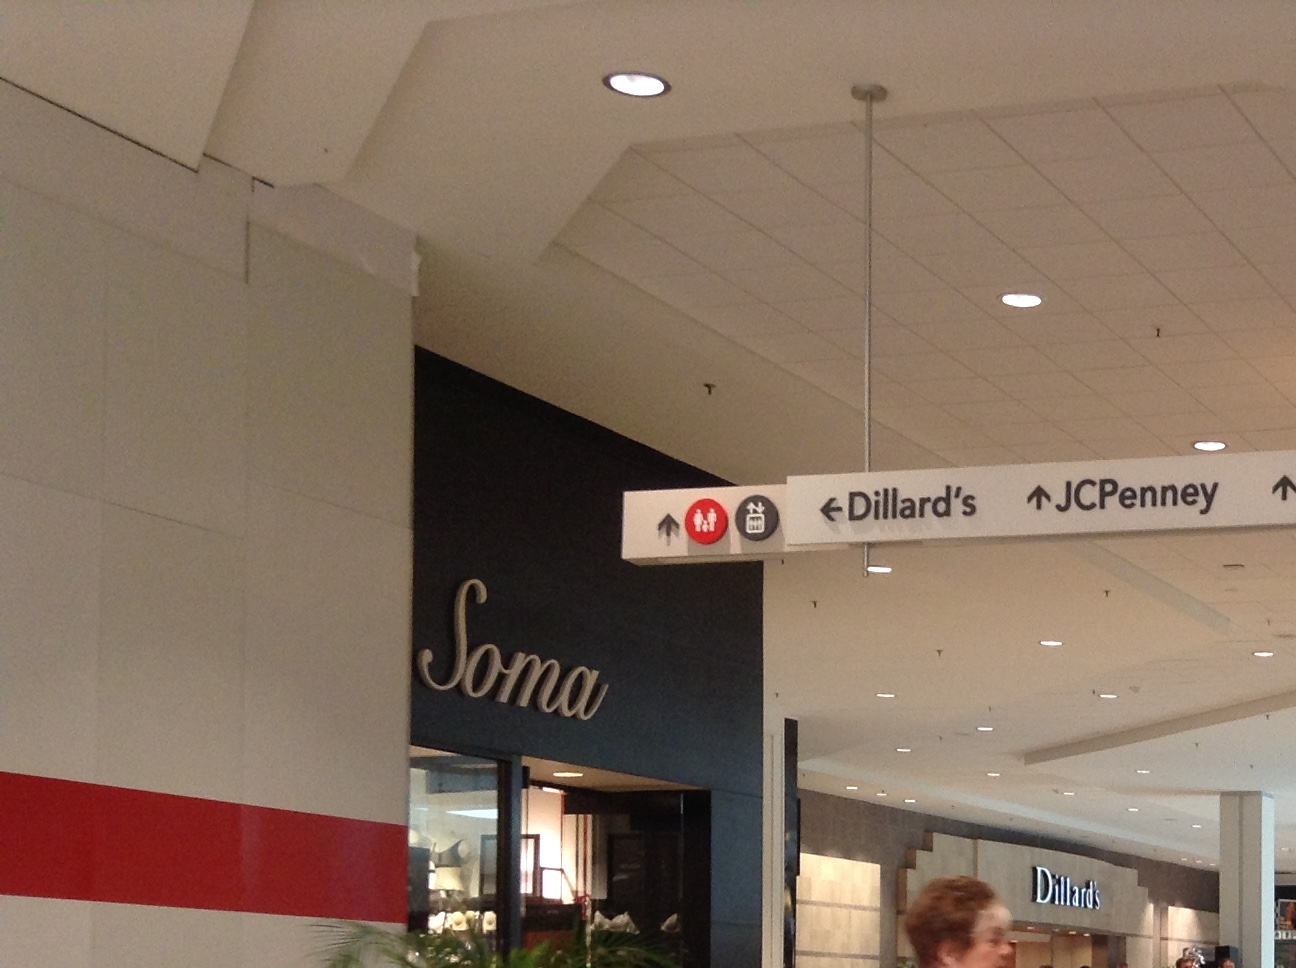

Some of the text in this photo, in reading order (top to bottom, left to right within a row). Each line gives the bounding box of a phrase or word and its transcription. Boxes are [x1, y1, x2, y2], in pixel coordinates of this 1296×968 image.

[847, 485, 977, 522] Dillard's
[1055, 477, 1219, 515] JCPenney
[416, 578, 610, 721] Soma
[1031, 865, 1101, 910] Dillard's
